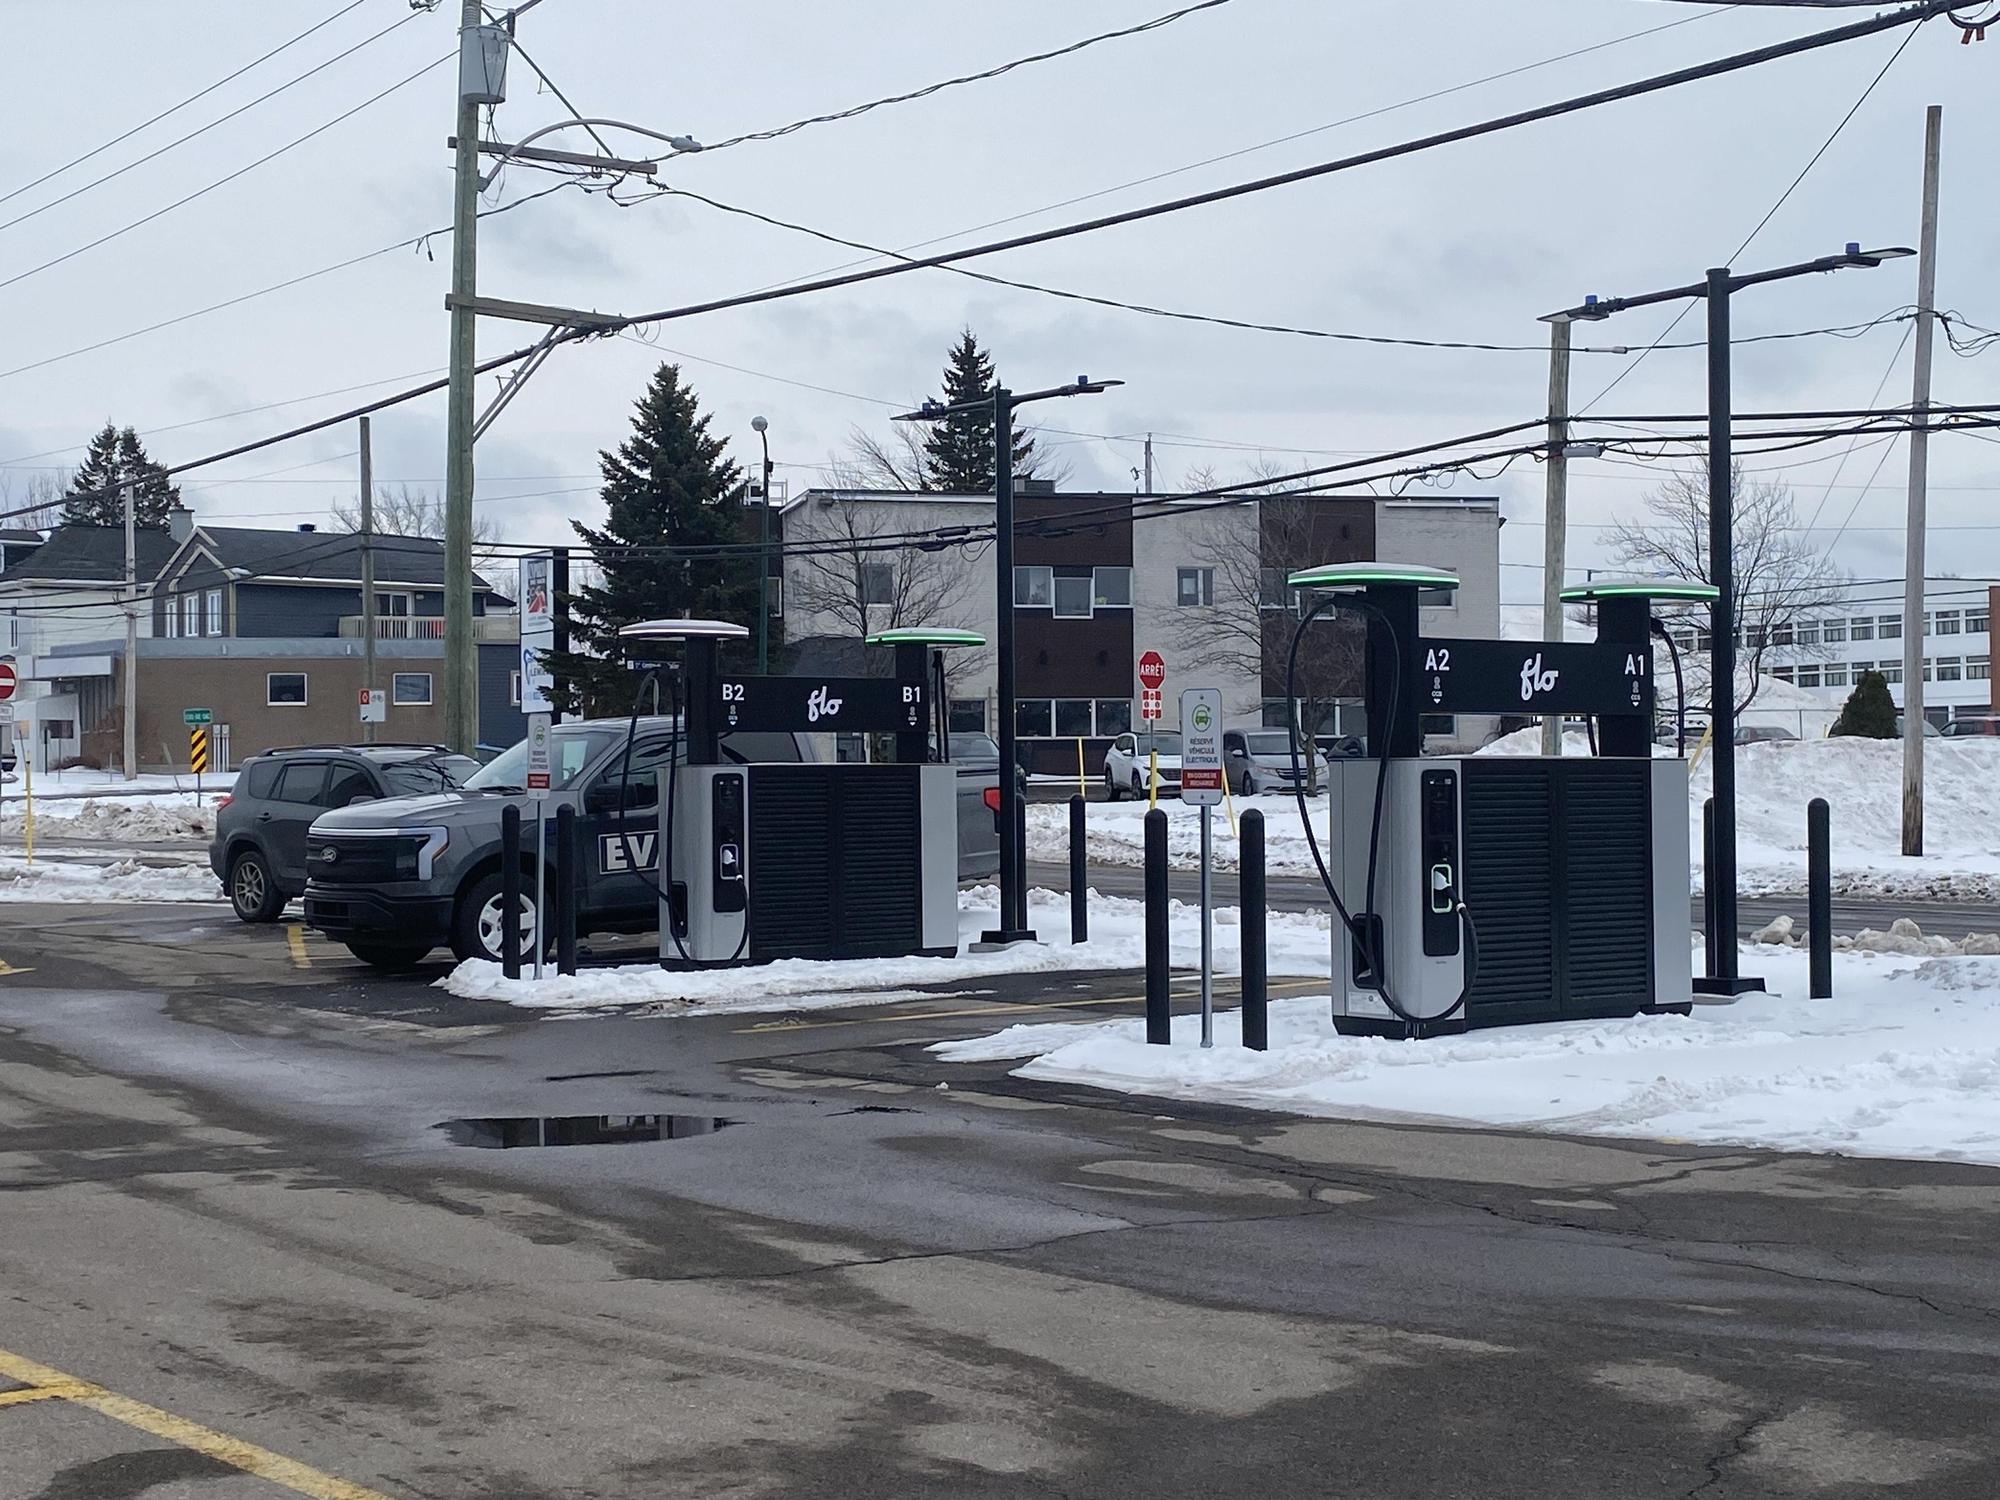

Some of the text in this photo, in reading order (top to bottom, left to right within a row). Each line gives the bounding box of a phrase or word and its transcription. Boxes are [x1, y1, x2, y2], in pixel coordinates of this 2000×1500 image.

[1140, 662, 1164, 677] ARRÊT
[1425, 648, 1450, 671] A2
[1624, 653, 1645, 676] A1
[1520, 653, 1559, 701] flo
[722, 684, 745, 701] B2
[807, 686, 843, 722] flo
[902, 686, 921, 703] B1
[606, 833, 659, 870] EV
